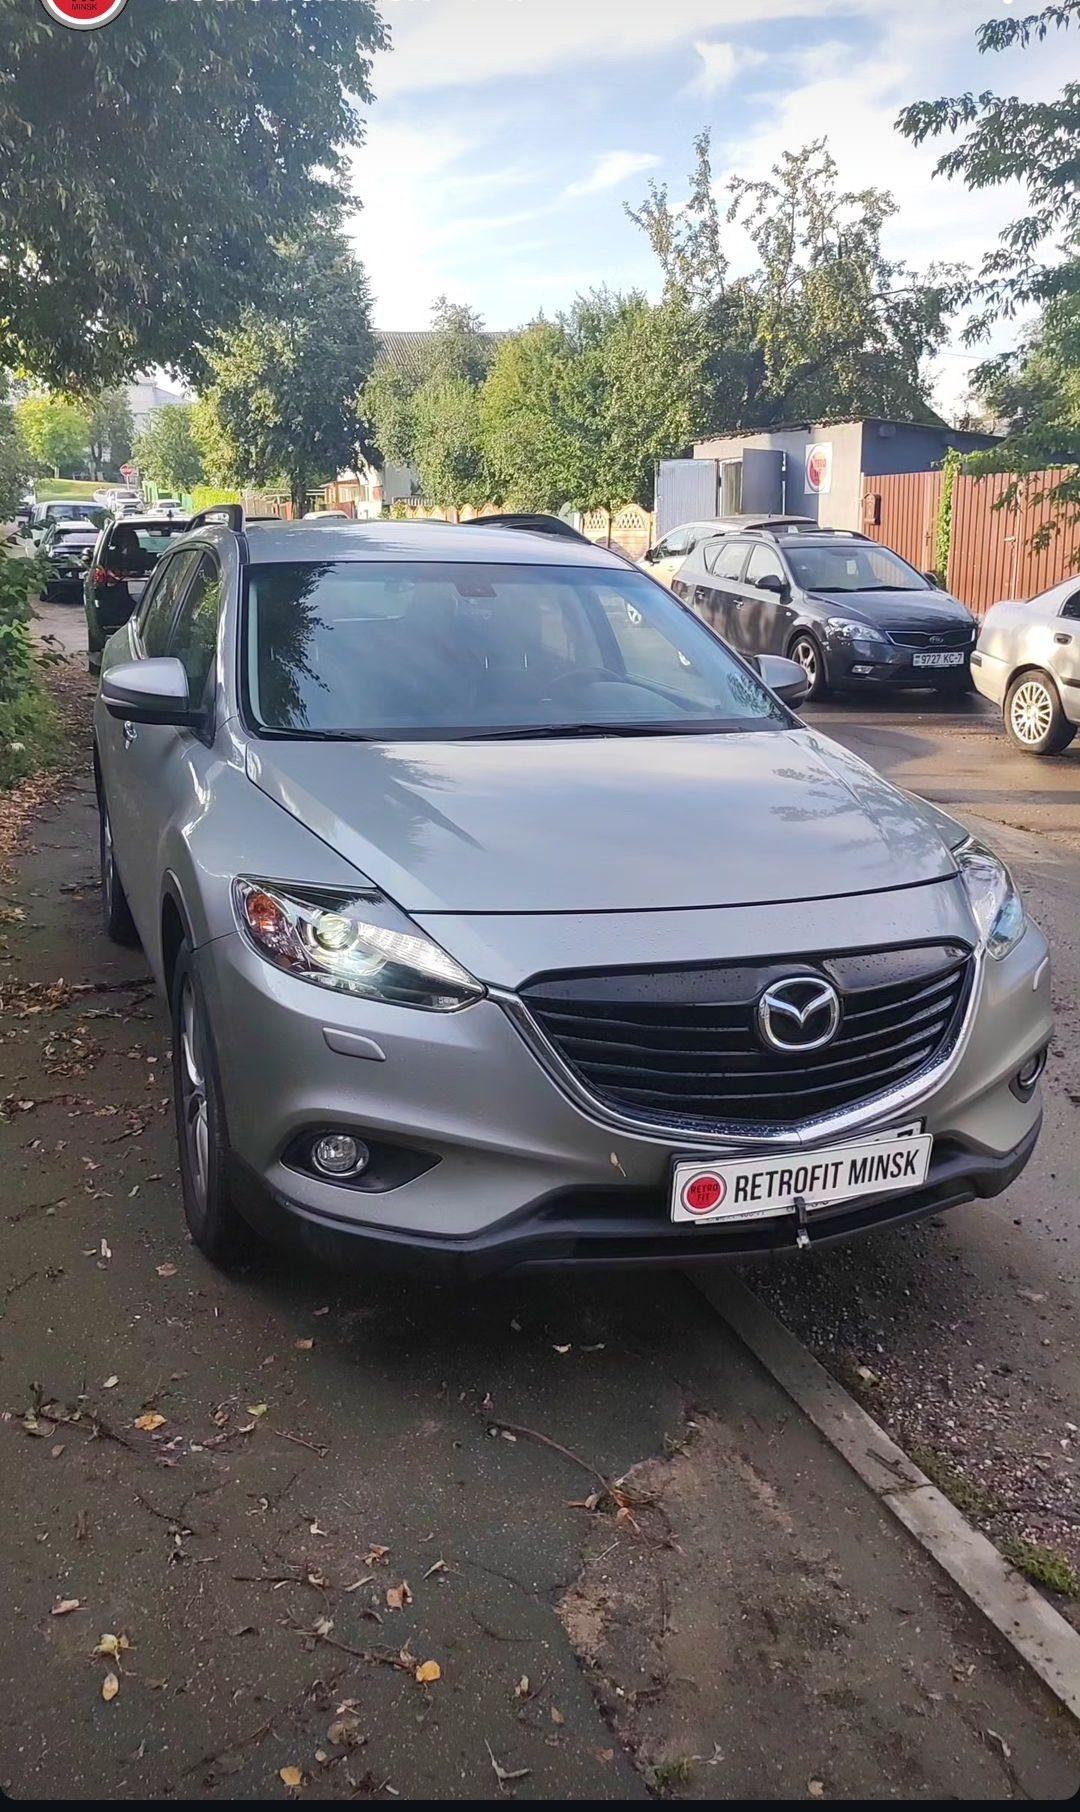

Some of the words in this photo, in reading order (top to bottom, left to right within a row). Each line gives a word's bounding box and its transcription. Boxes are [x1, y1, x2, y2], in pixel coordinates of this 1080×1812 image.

[921, 654, 941, 664] 9727
[944, 653, 962, 663] KC-7
[734, 1162, 843, 1203] RETROFIT
[848, 1149, 919, 1186] MINSK
[691, 1184, 718, 1194] RETRO
[697, 1193, 710, 1201] FIT
